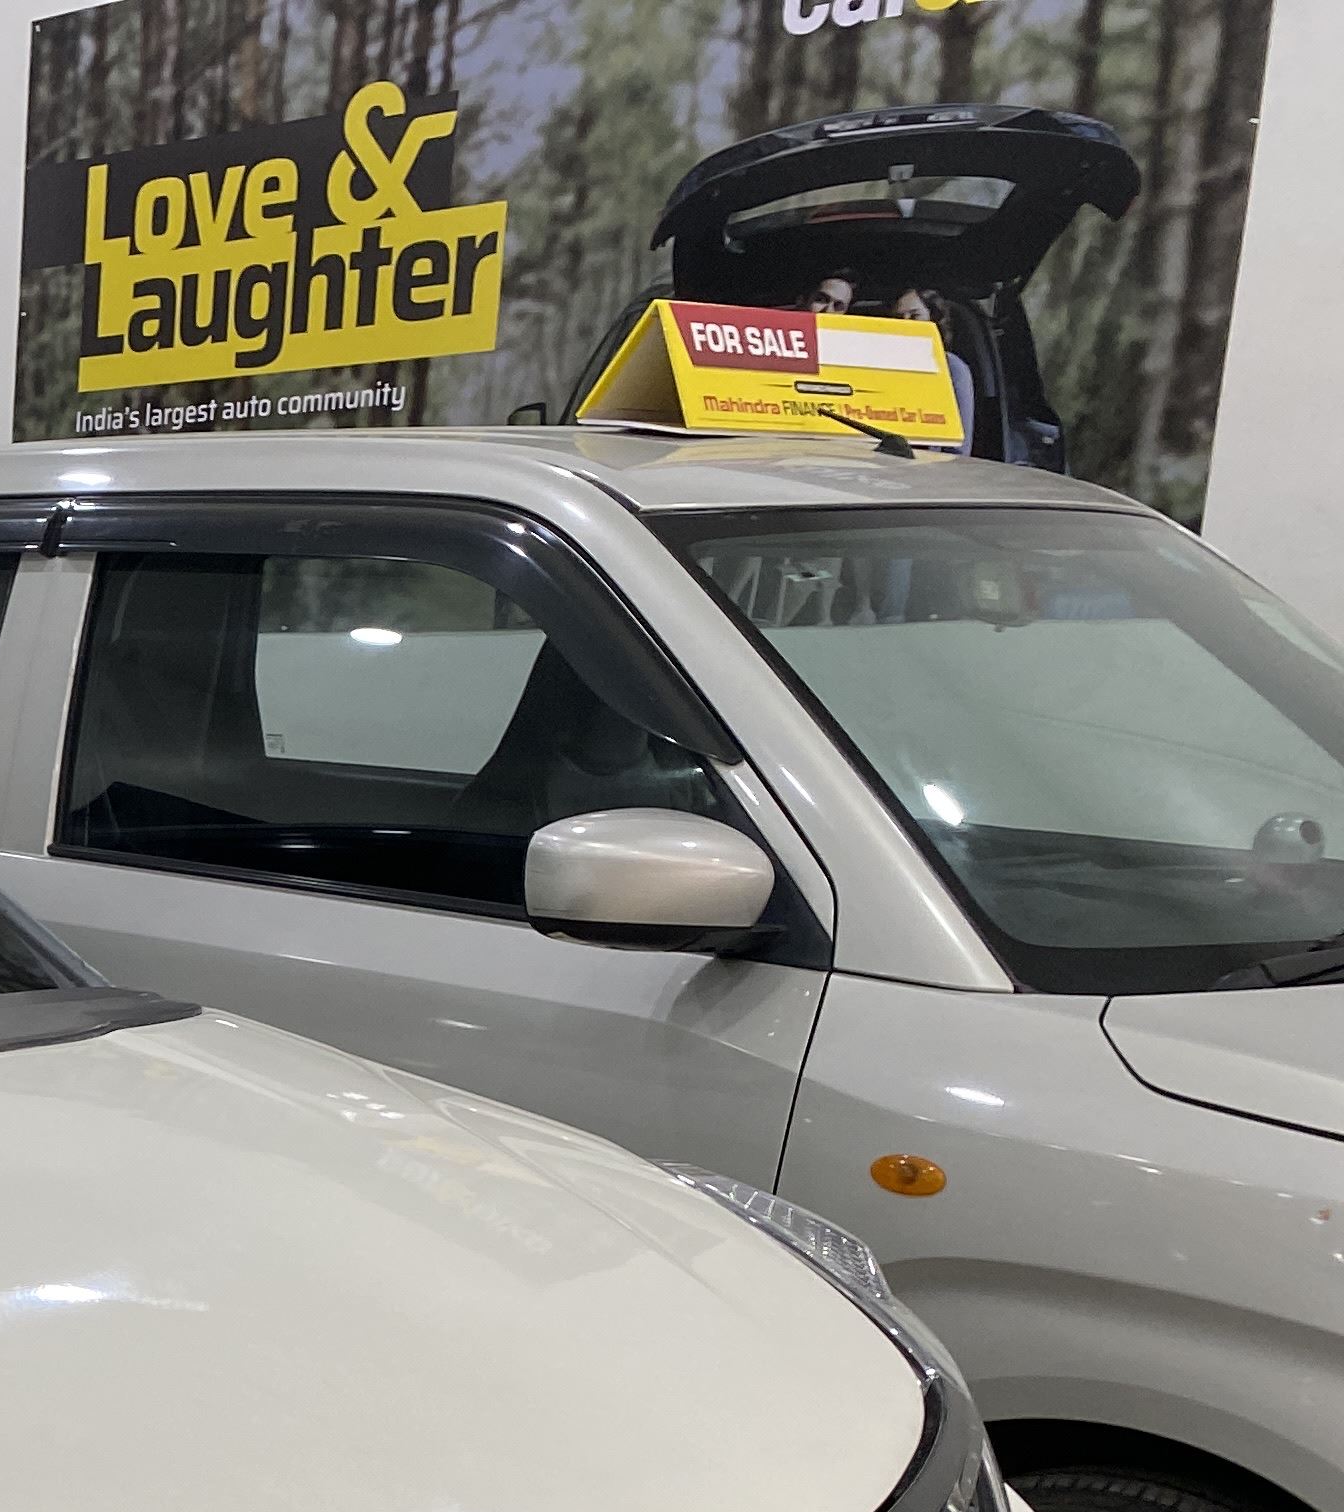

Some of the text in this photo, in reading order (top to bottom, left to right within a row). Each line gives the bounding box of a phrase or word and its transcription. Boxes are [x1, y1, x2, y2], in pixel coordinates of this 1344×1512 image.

[85, 80, 458, 256] Love &
[80, 226, 499, 369] Laughter
[690, 322, 809, 359] FOR SALE
[75, 381, 407, 432] India's largest auto community
